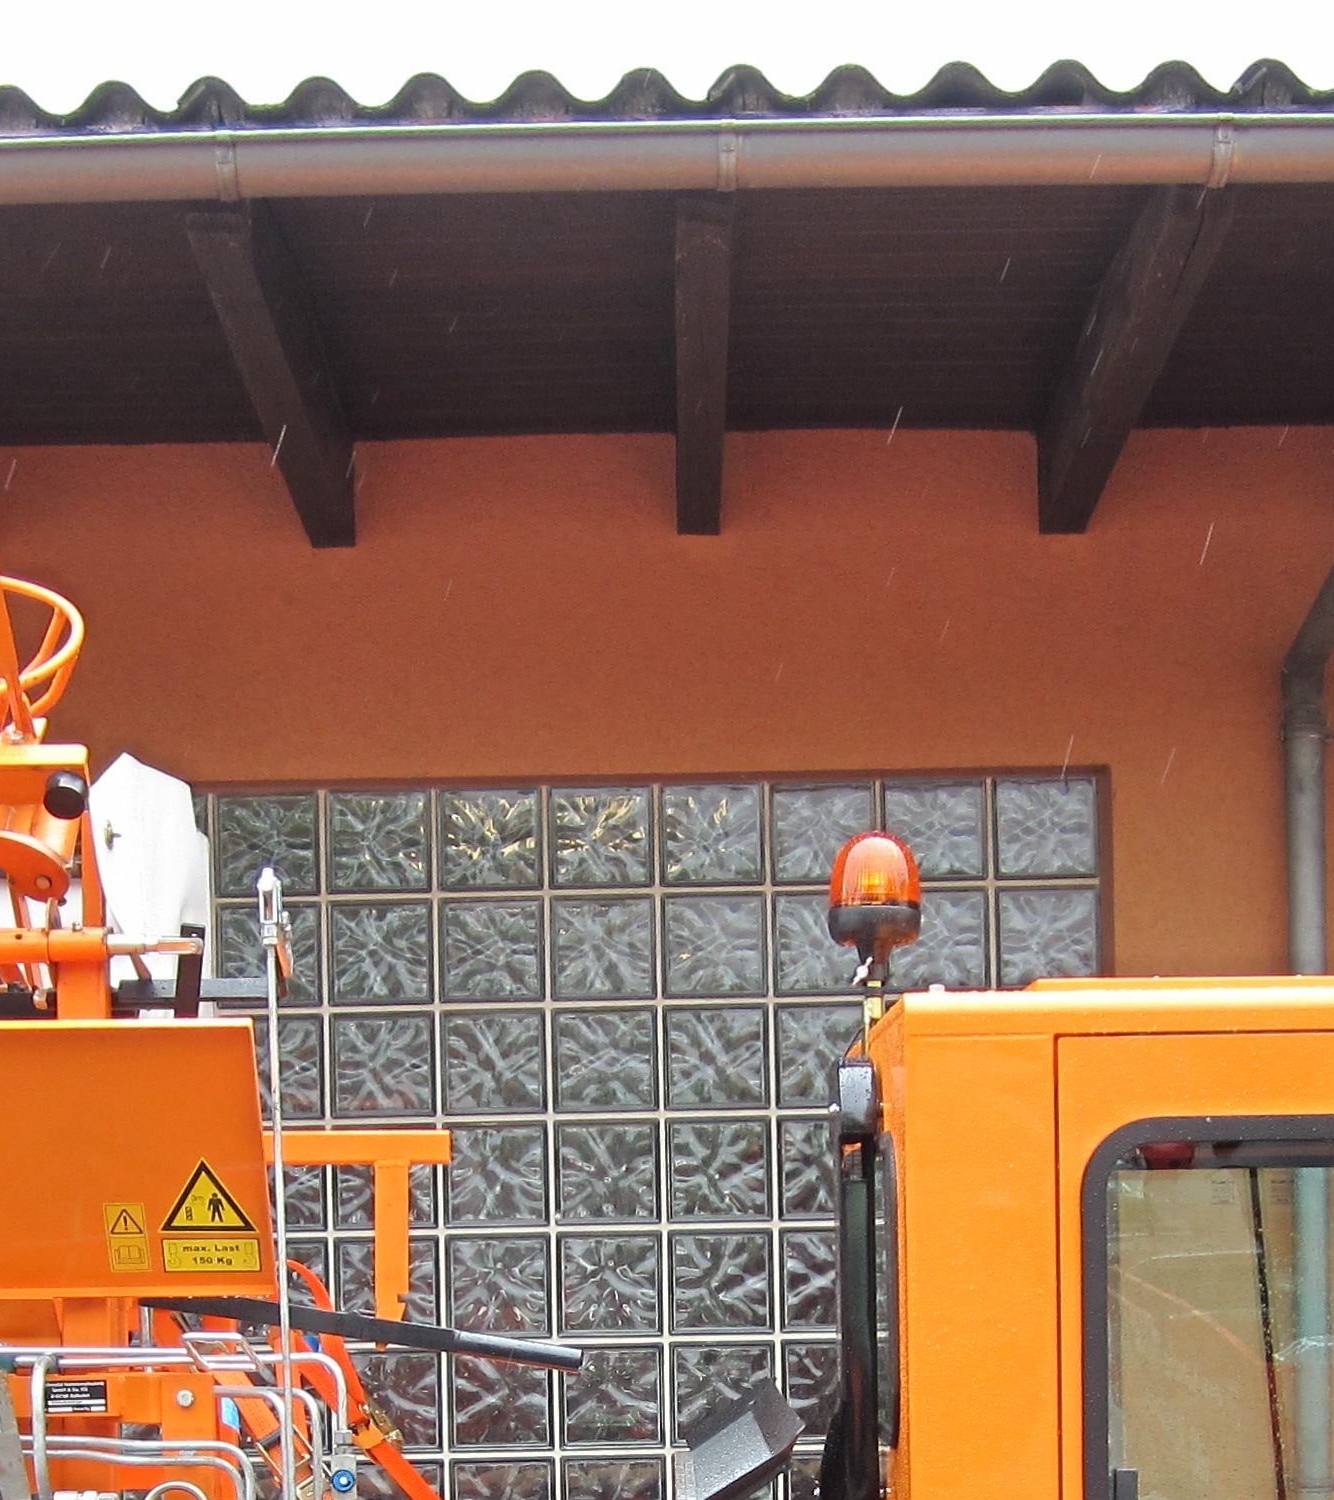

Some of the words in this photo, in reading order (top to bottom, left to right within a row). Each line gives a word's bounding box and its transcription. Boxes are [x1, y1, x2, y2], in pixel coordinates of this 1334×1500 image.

[182, 1244, 211, 1252] max.
[214, 1244, 240, 1252] Last
[193, 1256, 213, 1264] 150
[217, 1256, 233, 1266] Kg
